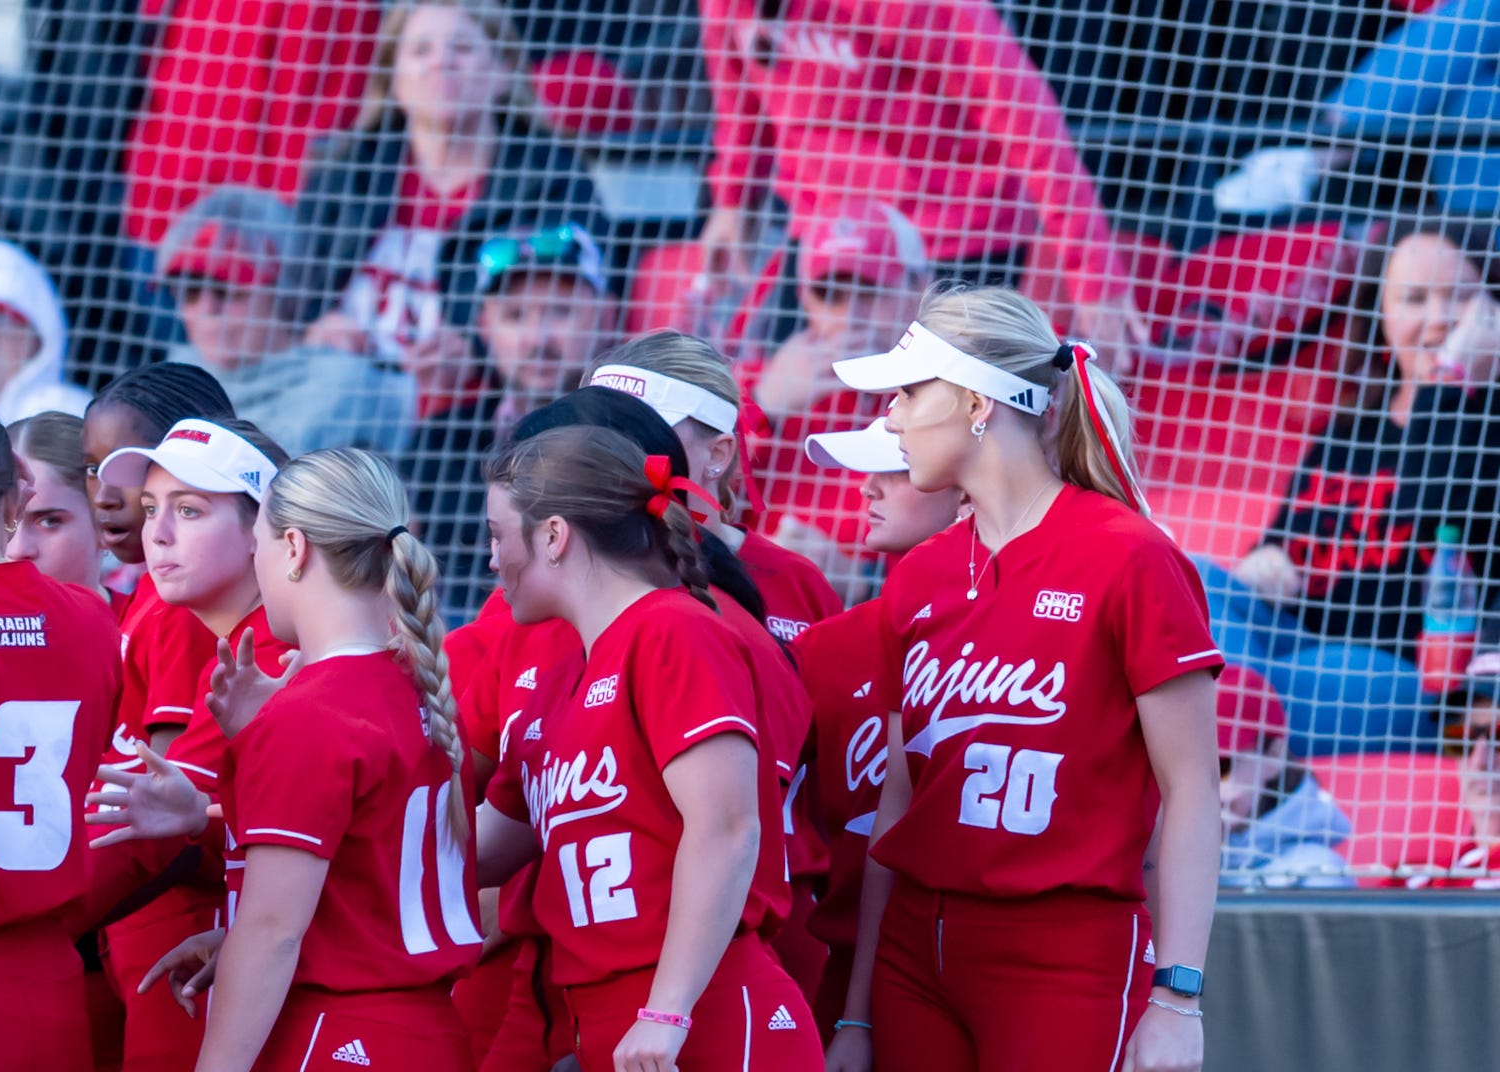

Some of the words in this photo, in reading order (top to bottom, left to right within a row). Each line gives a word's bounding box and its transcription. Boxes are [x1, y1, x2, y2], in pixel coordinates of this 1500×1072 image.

[1034, 591, 1084, 622] SBC
[584, 674, 618, 708] SBC
[958, 742, 1065, 835] 20
[400, 780, 483, 954] 11
[558, 832, 638, 928] 12
[332, 1052, 370, 1066] adidas
